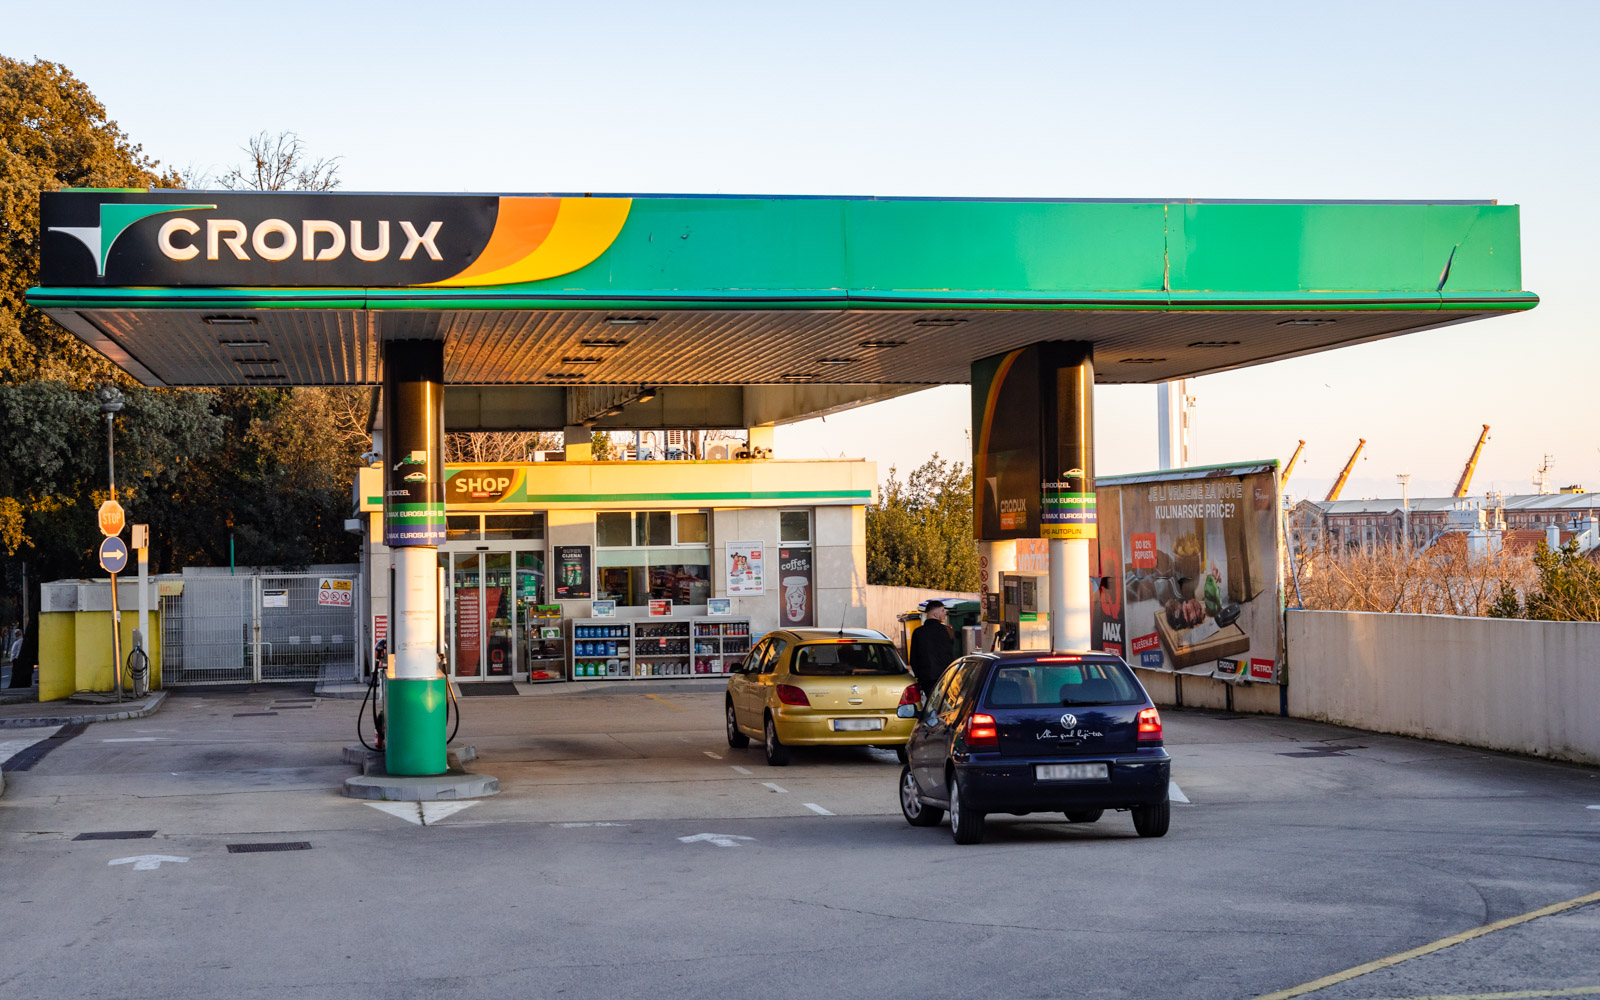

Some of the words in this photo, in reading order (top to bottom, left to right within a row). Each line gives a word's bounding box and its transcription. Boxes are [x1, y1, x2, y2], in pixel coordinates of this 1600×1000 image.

[157, 217, 444, 262] CRODUX
[455, 477, 510, 493] SHOP
[1205, 483, 1217, 499] ZA
[1218, 482, 1243, 499] NOVE
[1000, 498, 1027, 513] CRODUX
[1155, 503, 1204, 519] KULINARSKE
[1205, 500, 1235, 518] PRIČE?
[102, 512, 121, 525] STOP
[781, 559, 807, 571] coffee
[1102, 622, 1122, 642] MAX
[1253, 663, 1273, 674] PETROL
